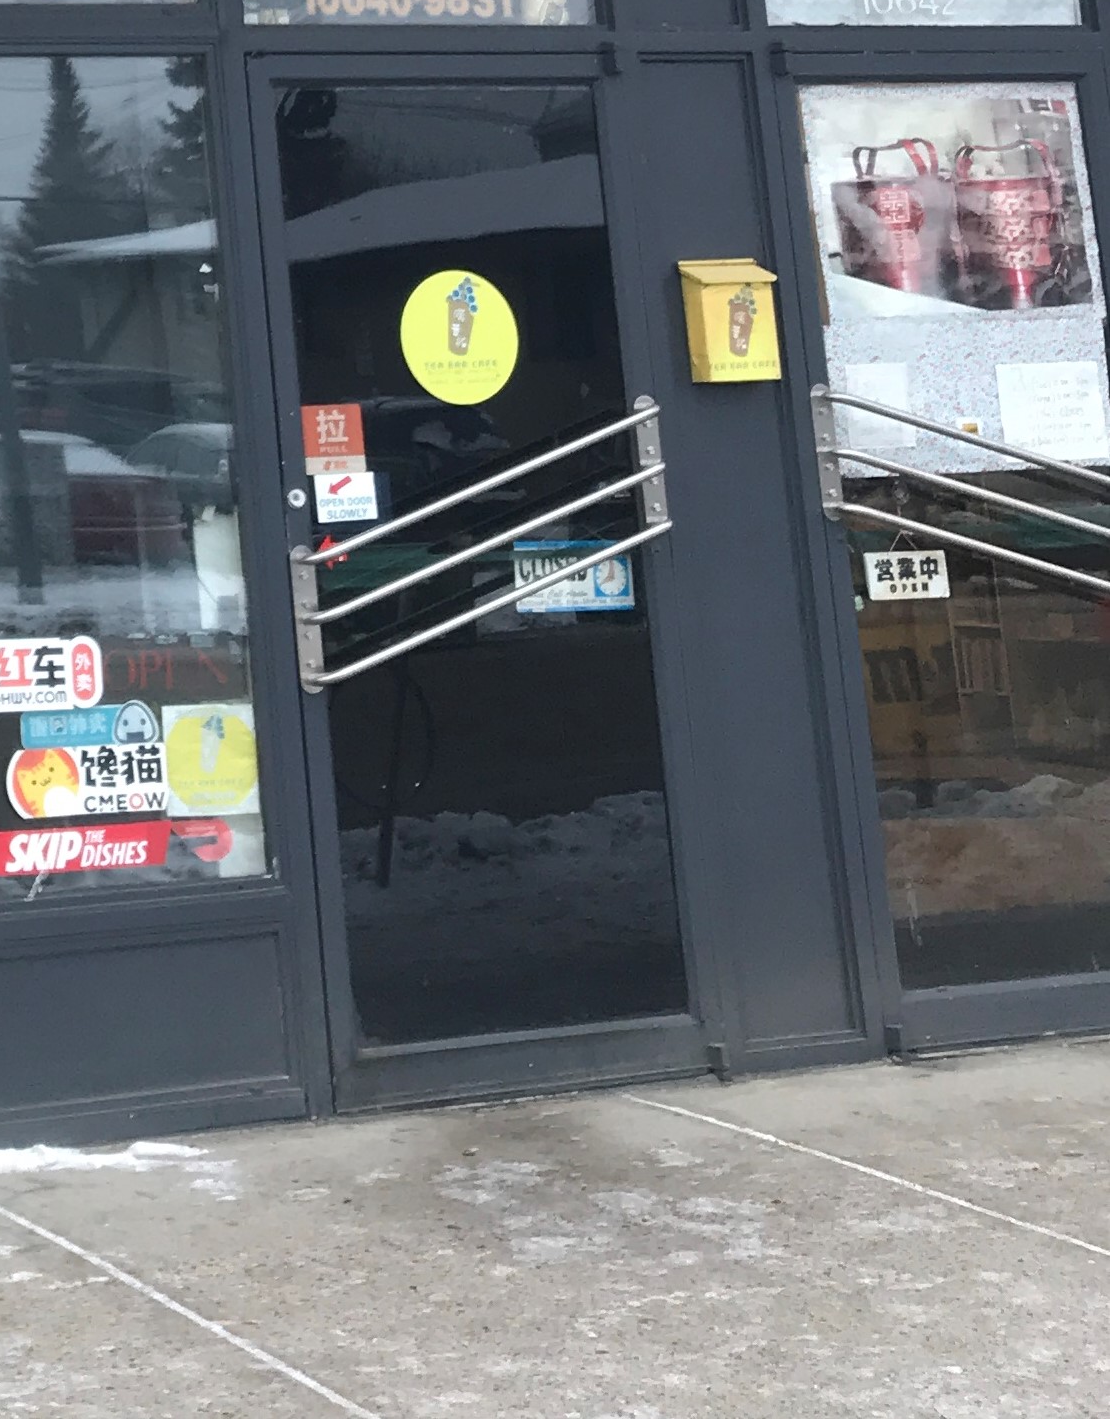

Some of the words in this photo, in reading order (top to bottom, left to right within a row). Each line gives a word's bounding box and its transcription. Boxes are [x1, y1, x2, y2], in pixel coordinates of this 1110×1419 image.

[316, 409, 349, 444] 拉
[319, 497, 345, 508] OPEN
[347, 496, 373, 506] DOOR
[326, 508, 368, 520] SLOWLY
[80, 745, 163, 788] 馋猫
[84, 791, 165, 813] CMEOW
[85, 829, 106, 843] THE
[5, 830, 84, 873] SKIP
[81, 840, 148, 868] DISHES
